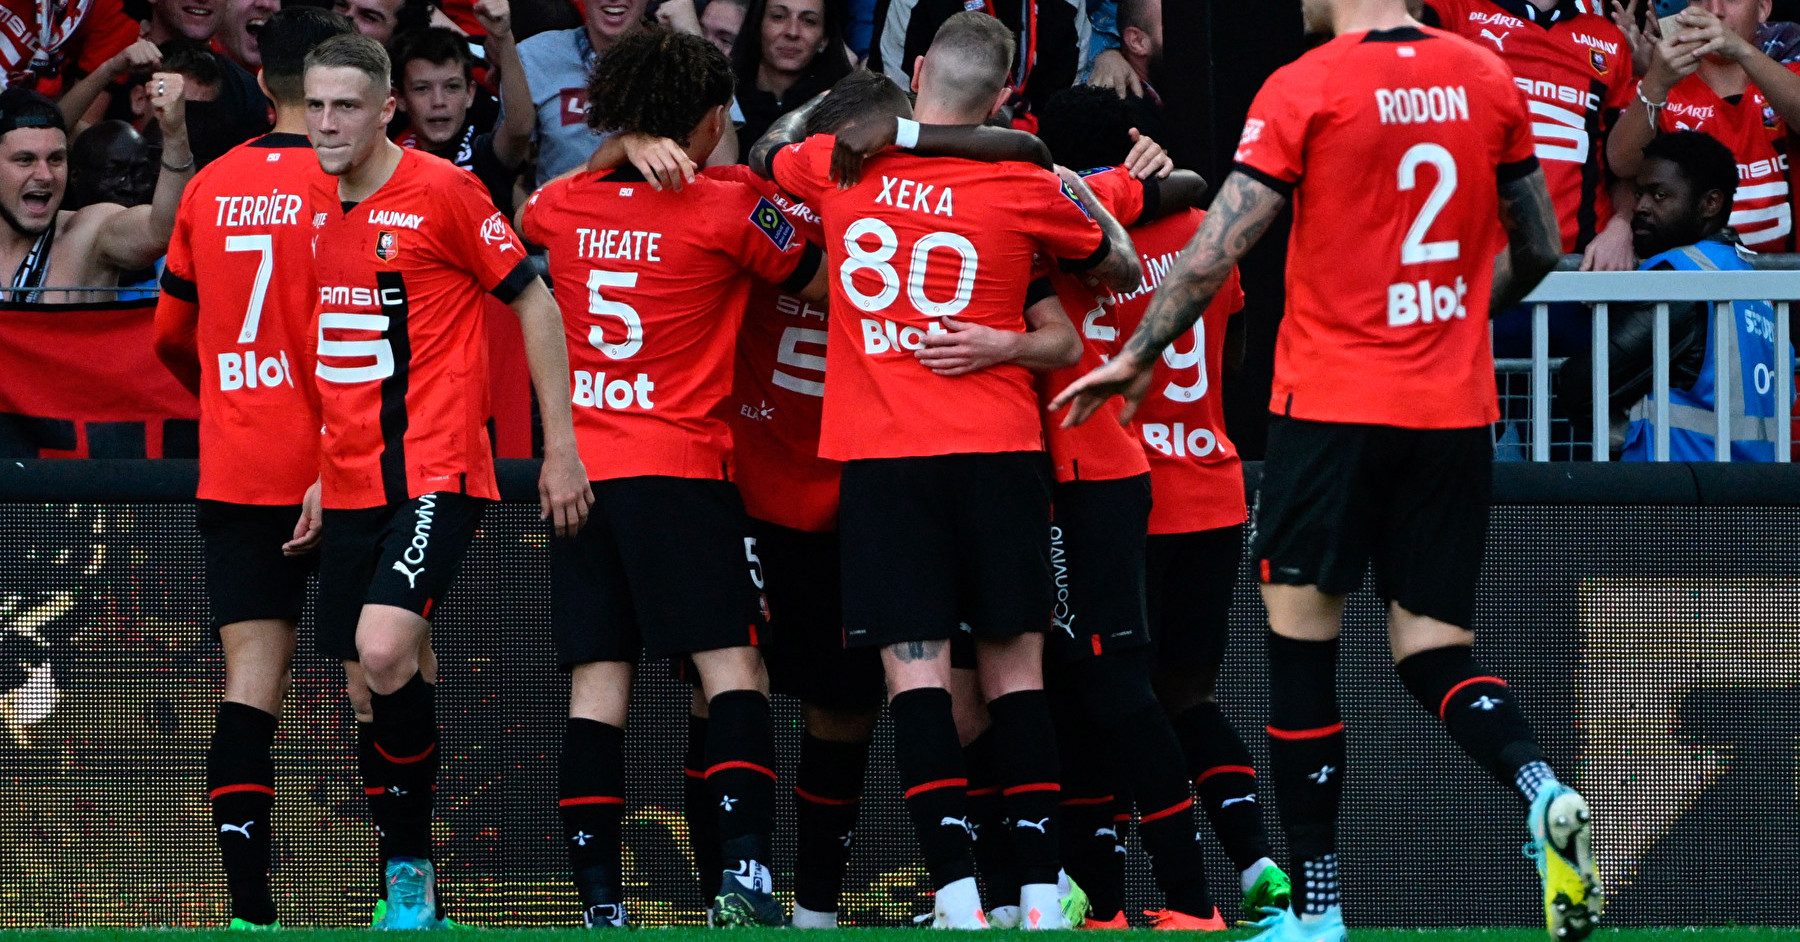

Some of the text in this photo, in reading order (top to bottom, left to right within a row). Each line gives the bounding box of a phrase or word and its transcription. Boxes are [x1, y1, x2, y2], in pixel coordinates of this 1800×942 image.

[1572, 32, 1618, 54] LAUNAY
[1374, 85, 1470, 125] RODON
[368, 209, 424, 230] LAUNAY
[875, 175, 953, 217] XEKA
[1397, 142, 1459, 265] 2
[576, 228, 661, 262] THEATE
[840, 217, 979, 317] 80
[225, 234, 273, 343] 7
[319, 286, 403, 306] AMSIC
[1118, 250, 1181, 303] ALIM
[586, 270, 644, 361] 5
[571, 371, 654, 410] Blot
[1142, 422, 1225, 458] Blo
[403, 491, 437, 564] Convivi
[743, 537, 765, 589] 5
[1050, 527, 1069, 619] Convivio
